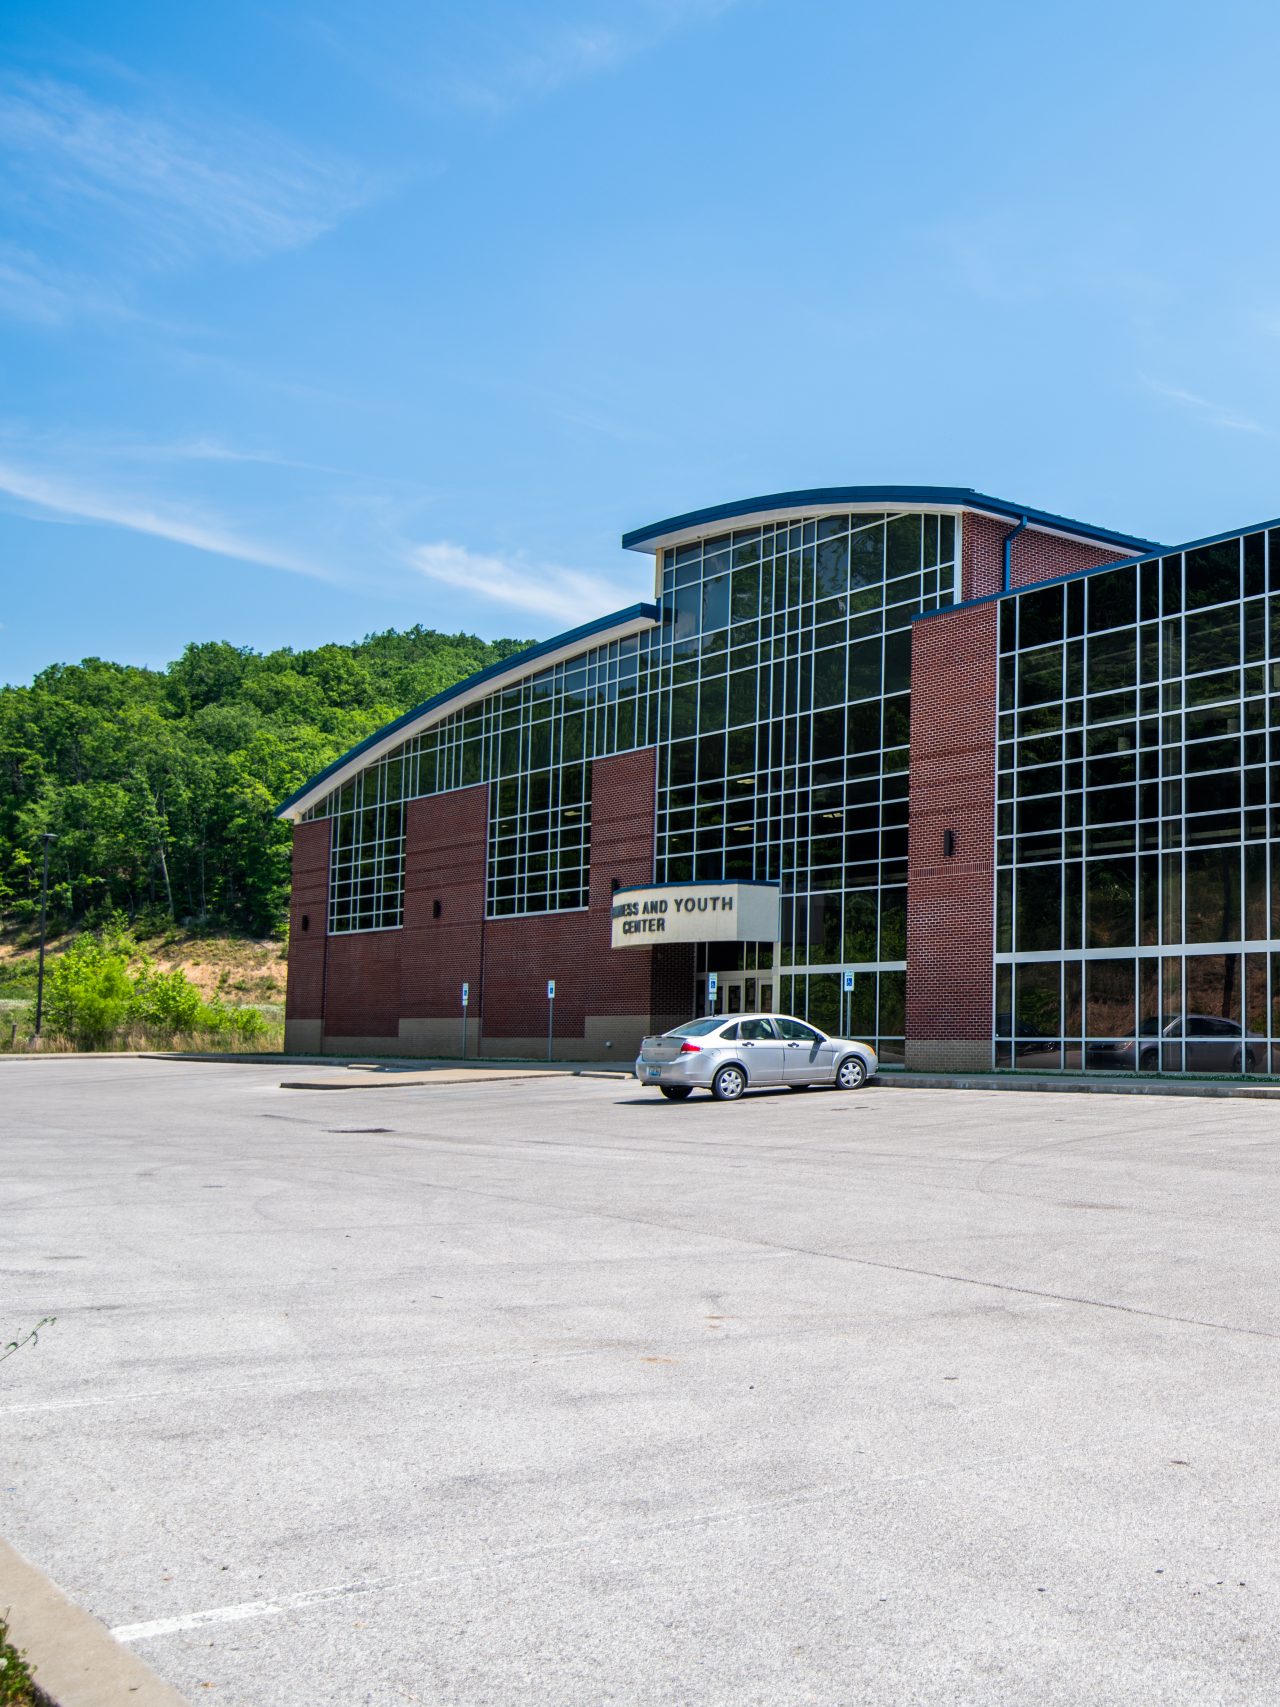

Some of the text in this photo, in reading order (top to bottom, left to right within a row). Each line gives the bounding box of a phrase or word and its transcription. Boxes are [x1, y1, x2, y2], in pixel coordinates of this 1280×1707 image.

[642, 900, 668, 914] AND
[674, 896, 733, 912] YOUTH
[623, 918, 665, 934] CENTER
